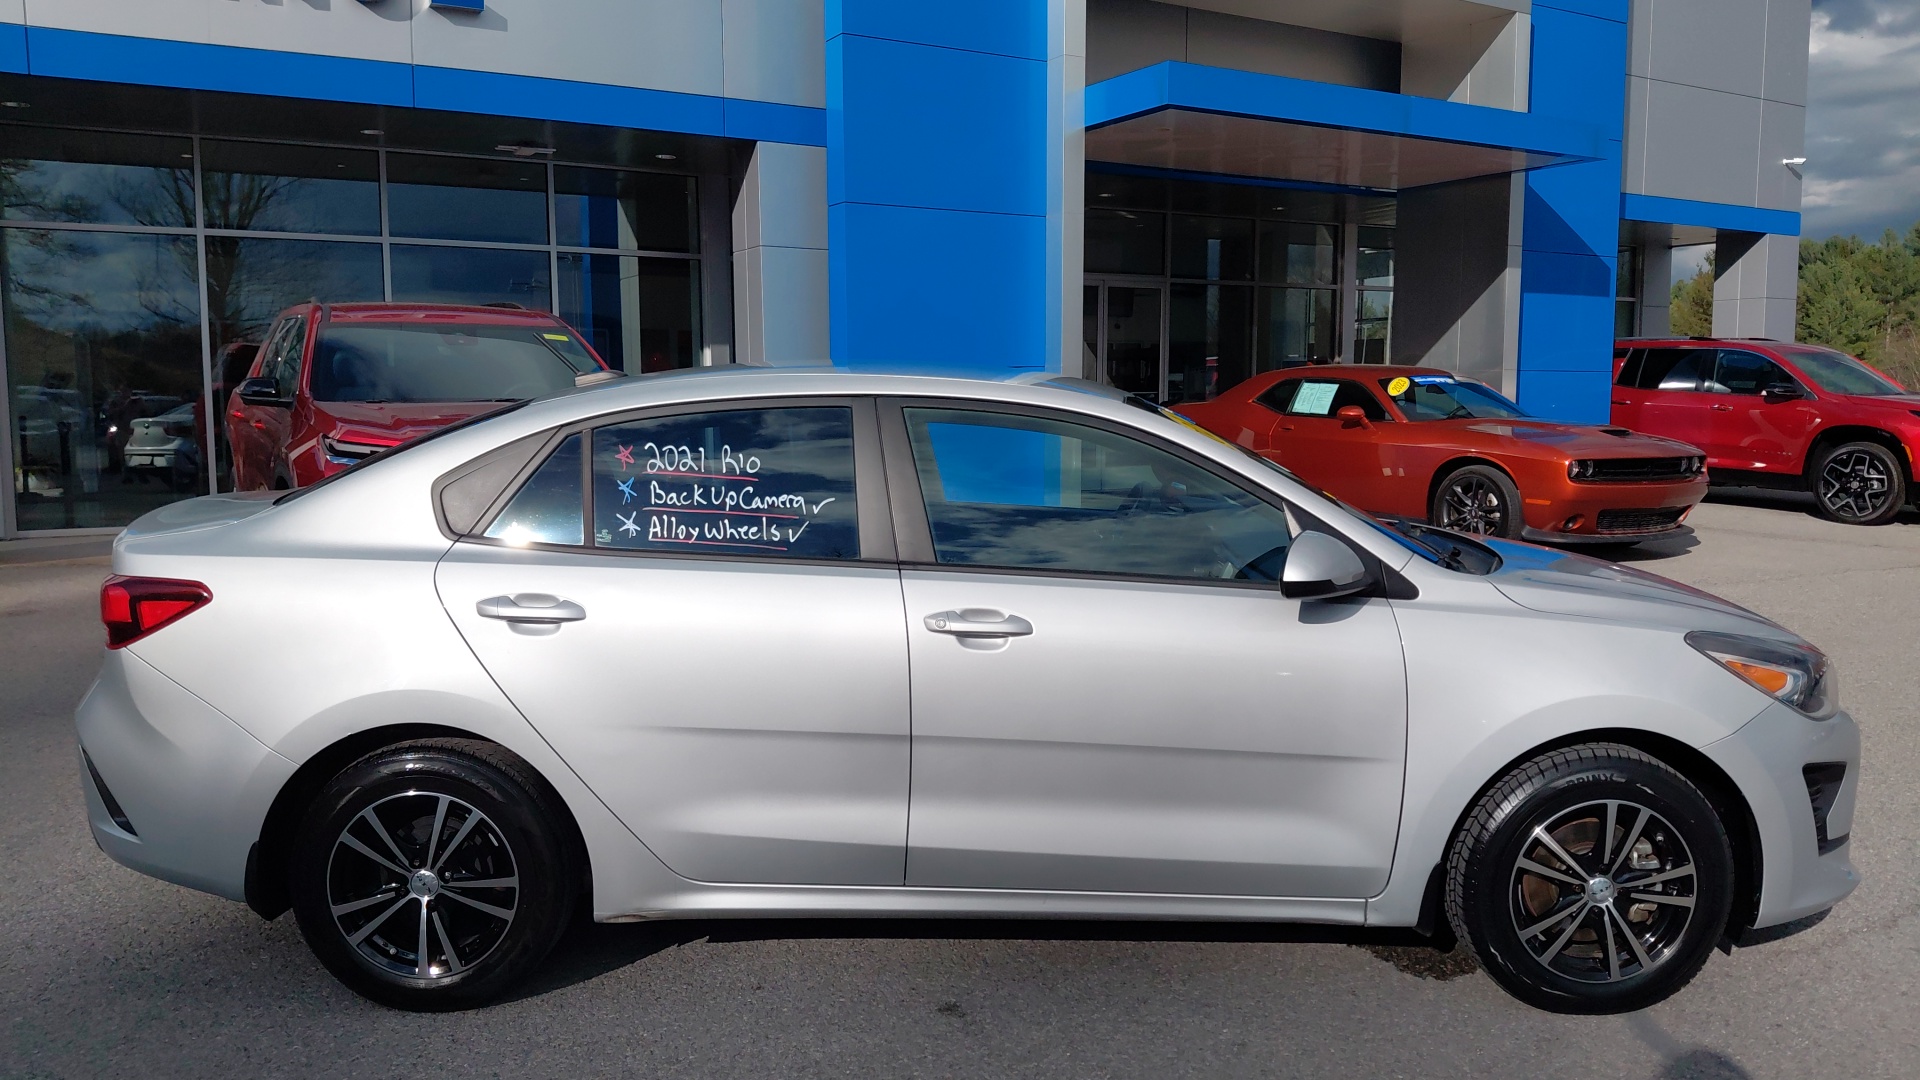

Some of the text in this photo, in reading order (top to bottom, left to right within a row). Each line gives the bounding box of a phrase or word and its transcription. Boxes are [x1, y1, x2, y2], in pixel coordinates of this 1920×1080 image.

[1391, 378, 1407, 393] 2023
[644, 442, 761, 475] 2021 Rio
[739, 486, 806, 515] Camera
[649, 515, 780, 543] Alloy Wheels
